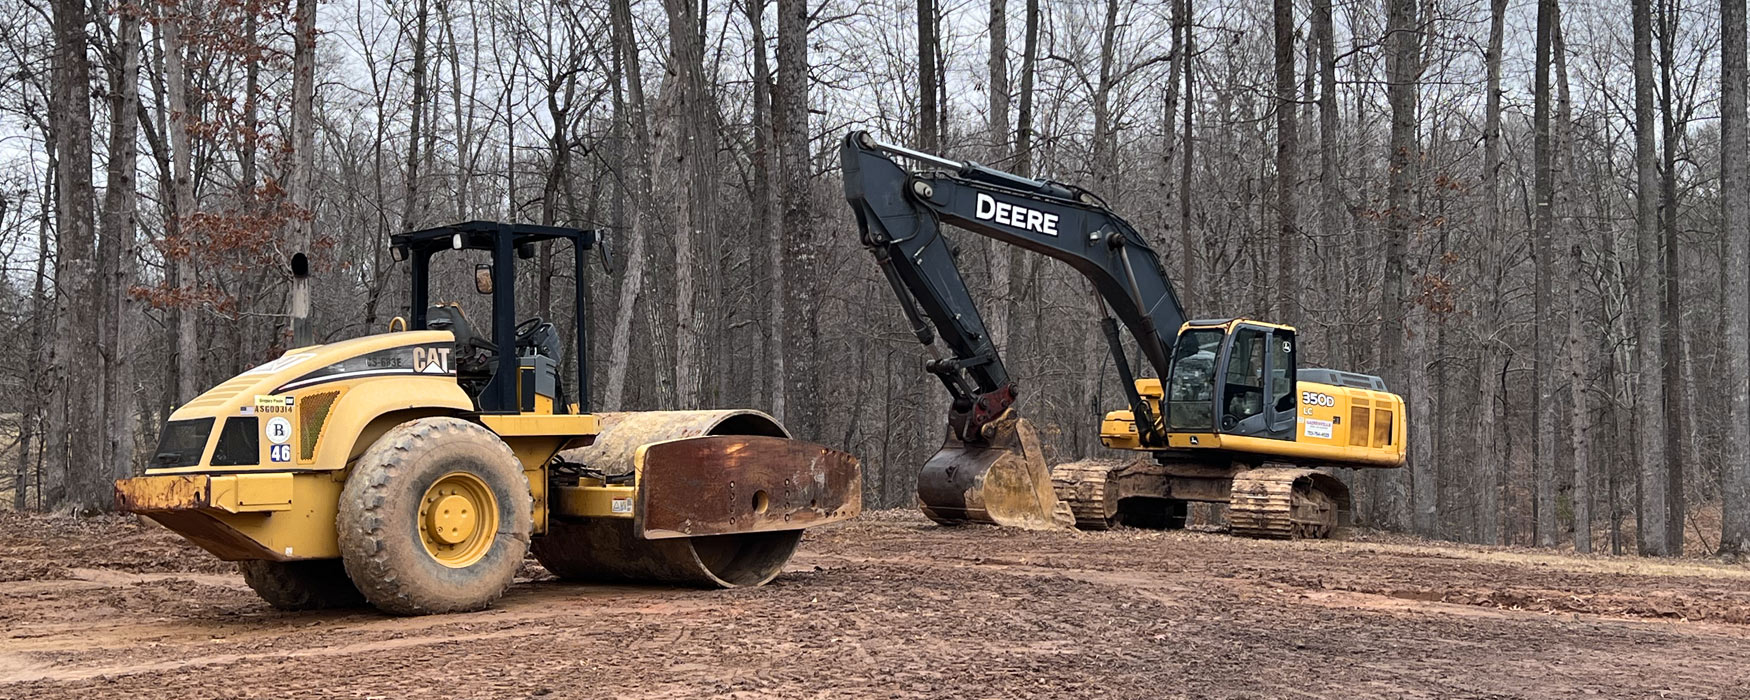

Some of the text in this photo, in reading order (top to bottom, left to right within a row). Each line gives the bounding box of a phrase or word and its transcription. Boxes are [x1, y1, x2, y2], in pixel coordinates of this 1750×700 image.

[976, 192, 1059, 236] DEERE
[412, 346, 450, 373] CAT
[1302, 391, 1335, 407] 350D
[1303, 407, 1313, 415] LC
[271, 445, 290, 461] 46
